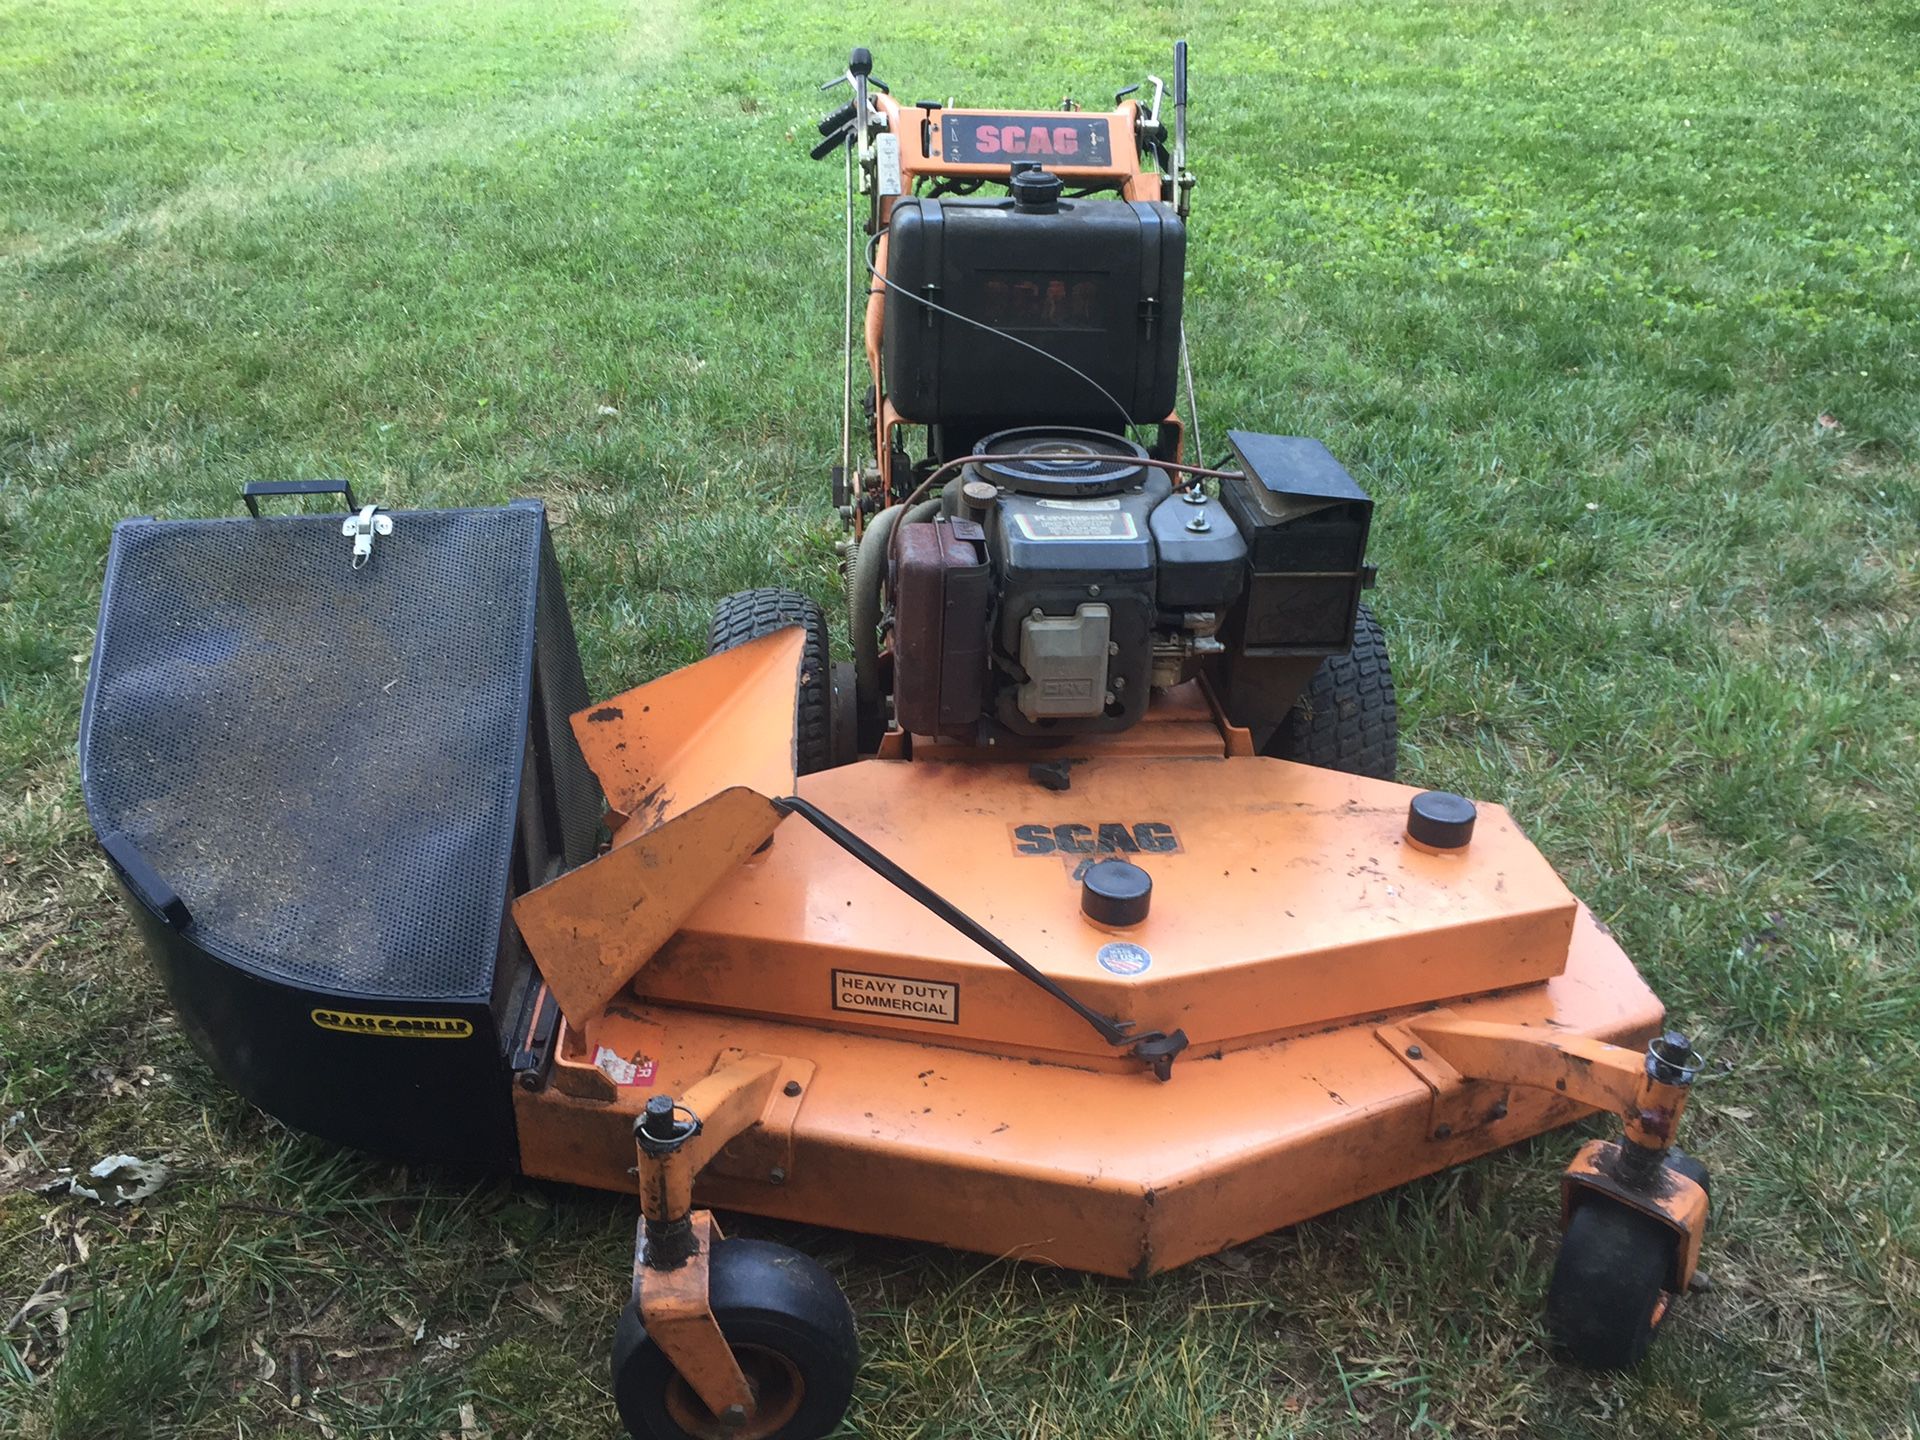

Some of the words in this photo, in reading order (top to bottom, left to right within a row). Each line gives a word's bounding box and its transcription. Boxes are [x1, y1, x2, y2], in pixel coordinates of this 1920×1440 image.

[975, 125, 1079, 155] SCAG
[1014, 823, 1178, 854] SCAG
[841, 977, 896, 993] HEAVY
[902, 984, 948, 1000] DUTY
[841, 992, 948, 1015] COMMERCIAL
[315, 1012, 377, 1030] GRASS
[378, 1019, 468, 1034] GOBBLER
